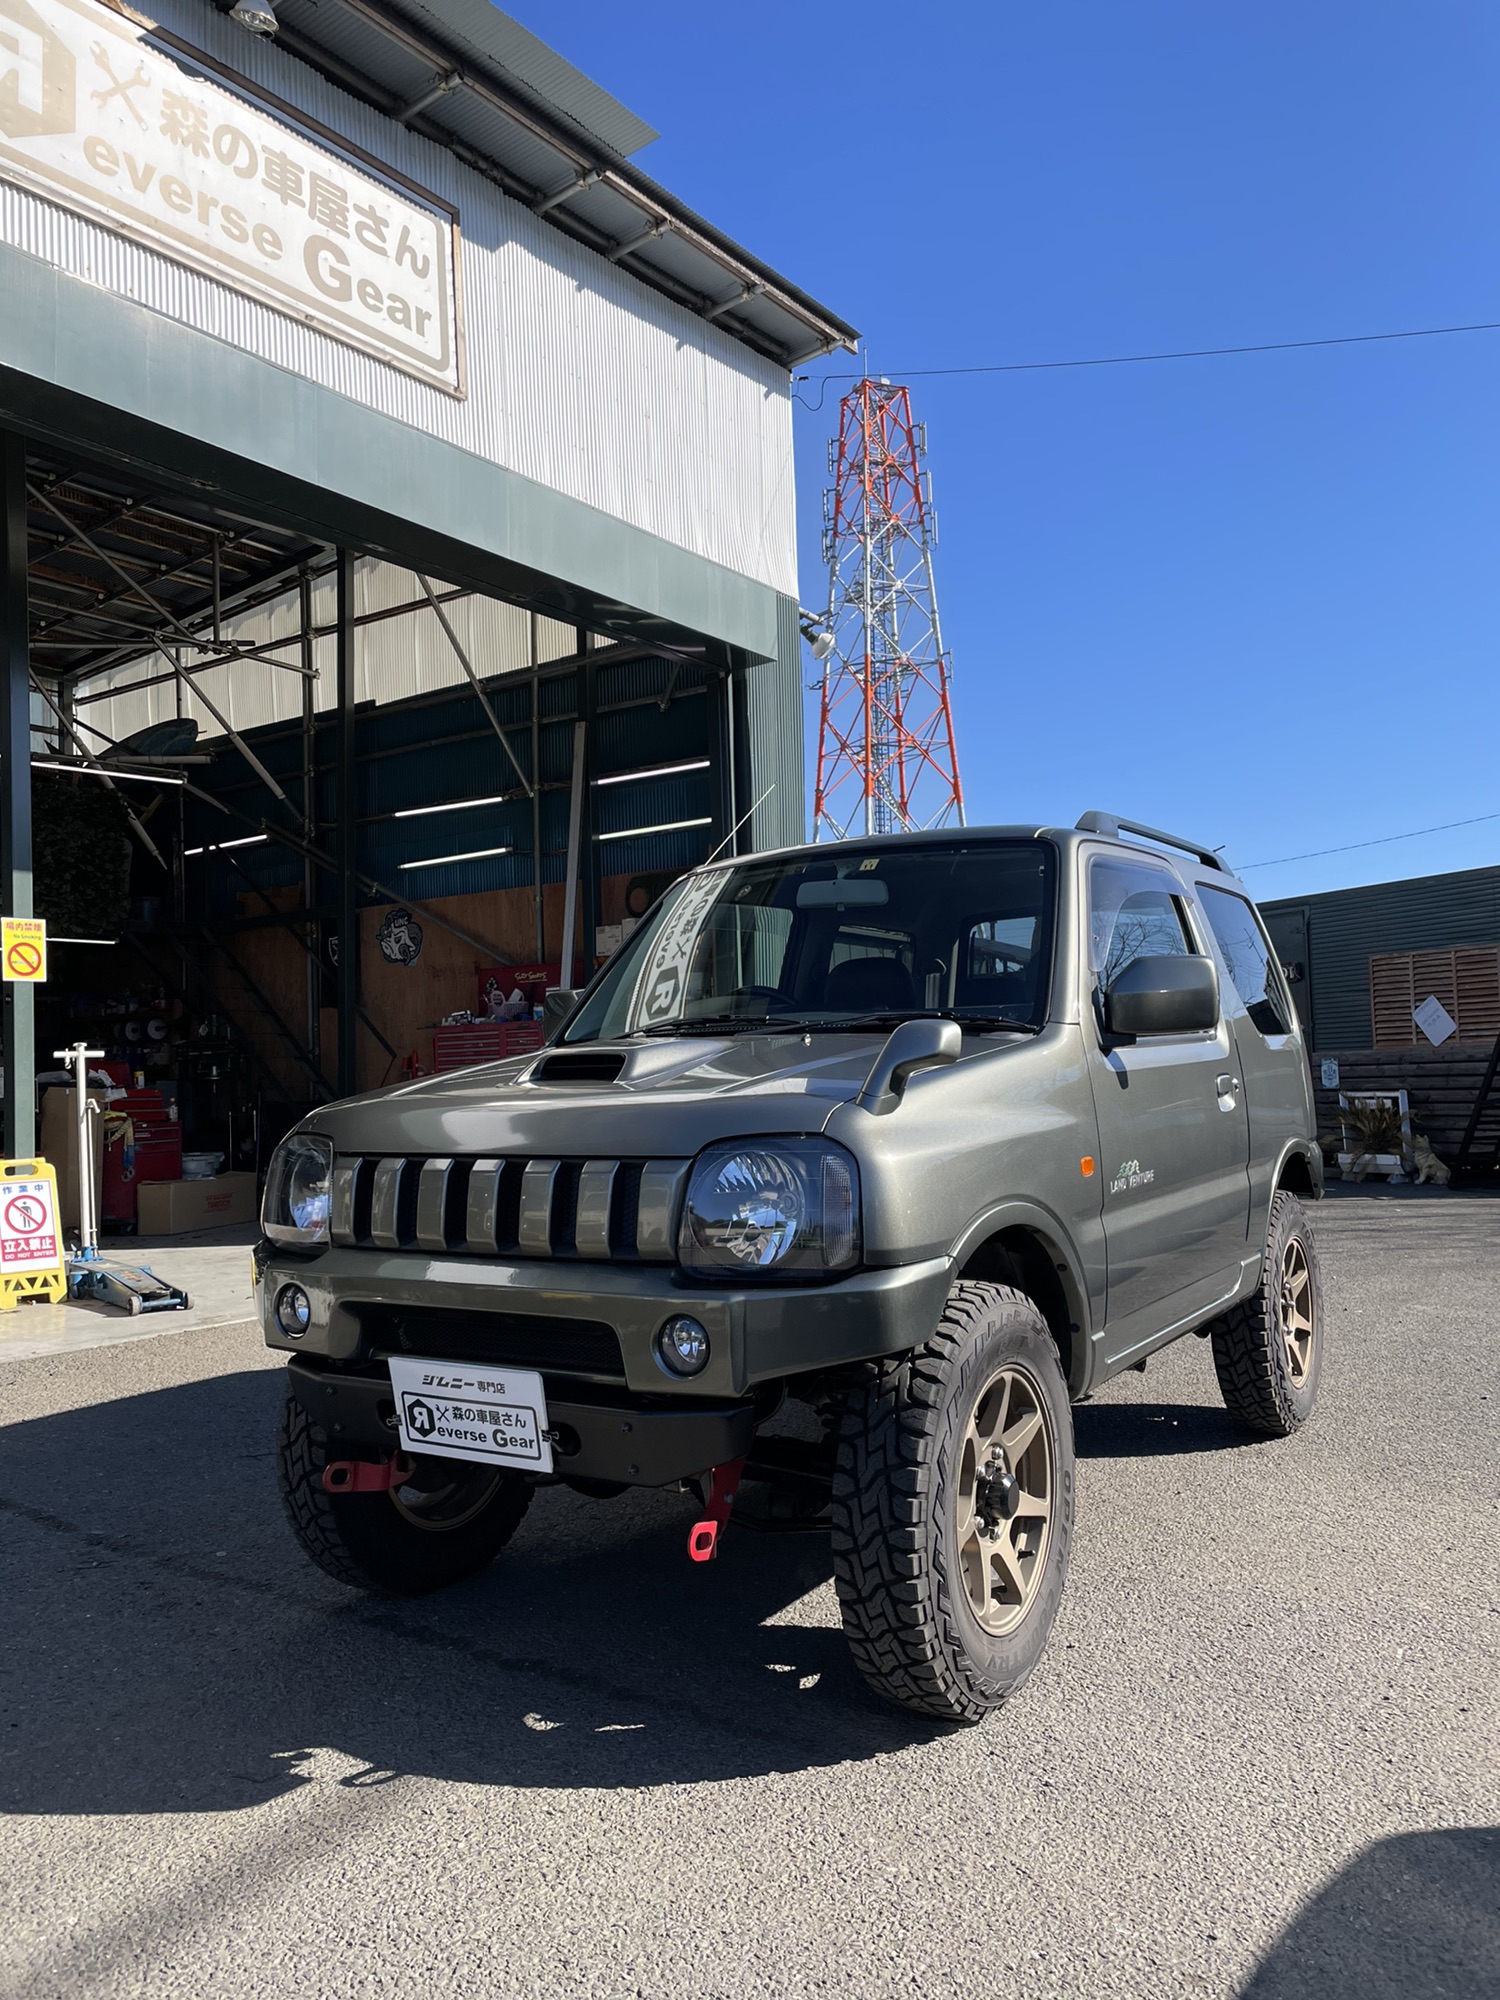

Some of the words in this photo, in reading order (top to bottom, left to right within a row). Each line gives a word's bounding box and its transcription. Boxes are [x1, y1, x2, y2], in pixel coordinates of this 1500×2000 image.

[159, 88, 430, 279] 森の車屋さん
[303, 234, 432, 338] Gear
[3, 1184, 44, 1195] 作業中
[4, 1237, 53, 1253] 立入禁止
[452, 1406, 527, 1428] 森の車屋さん
[492, 1428, 535, 1449] Gear
